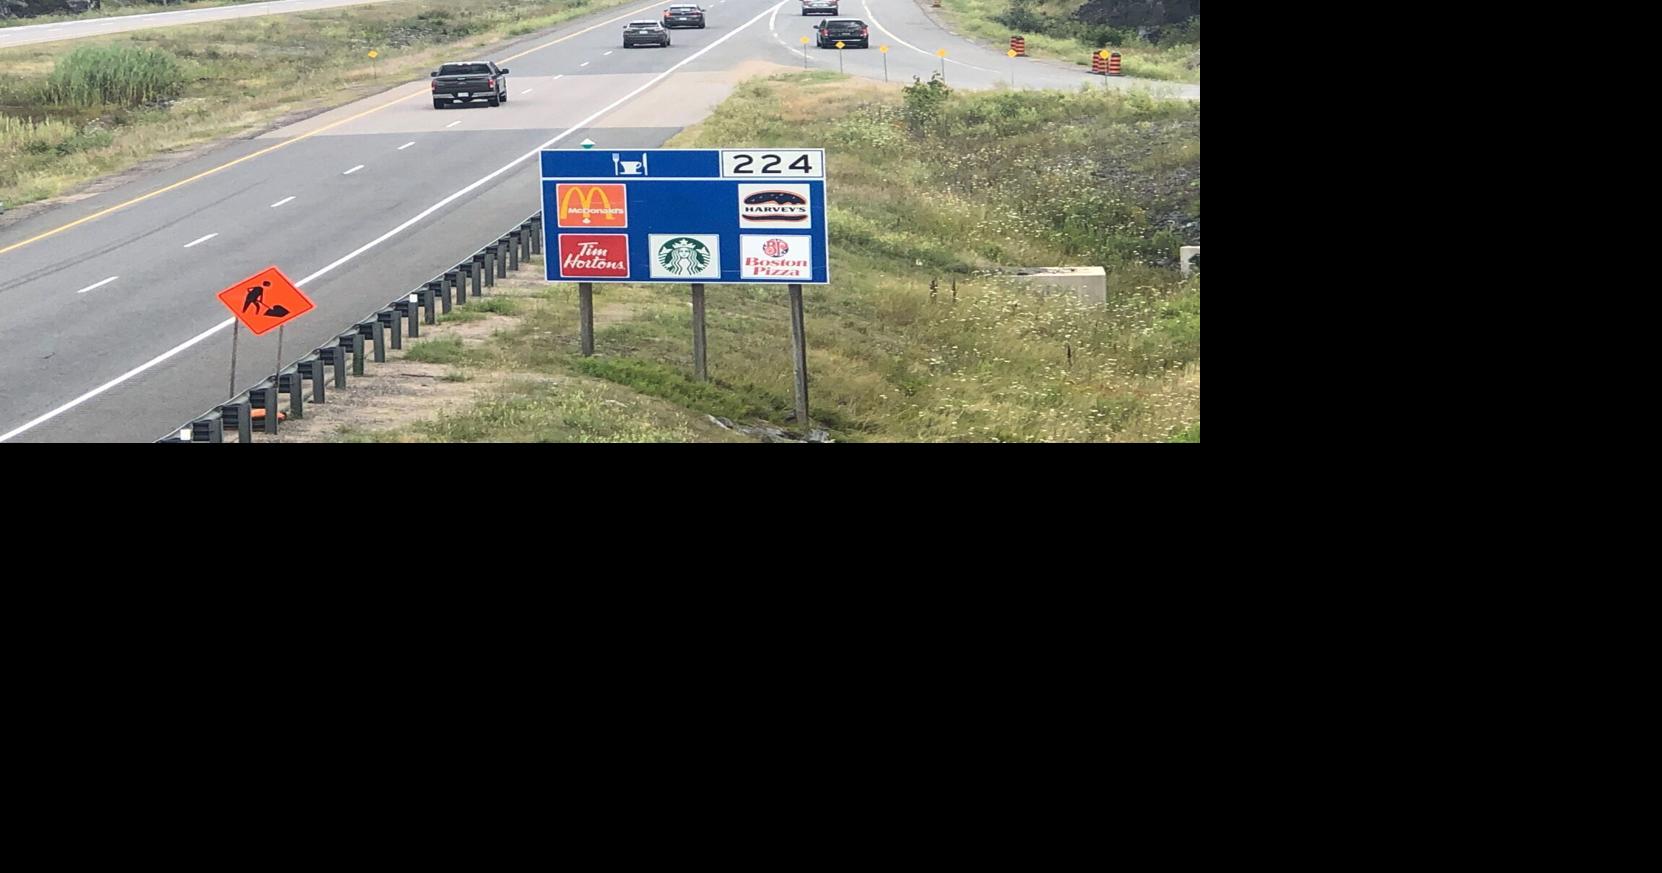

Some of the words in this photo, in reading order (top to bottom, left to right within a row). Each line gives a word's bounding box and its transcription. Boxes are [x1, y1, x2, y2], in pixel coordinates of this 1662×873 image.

[733, 154, 812, 173] 224
[568, 207, 624, 215] McDonald's
[578, 242, 607, 257] Tim
[563, 254, 624, 270] Hortons
[746, 257, 807, 267] Boston
[753, 266, 800, 276] Pizza
